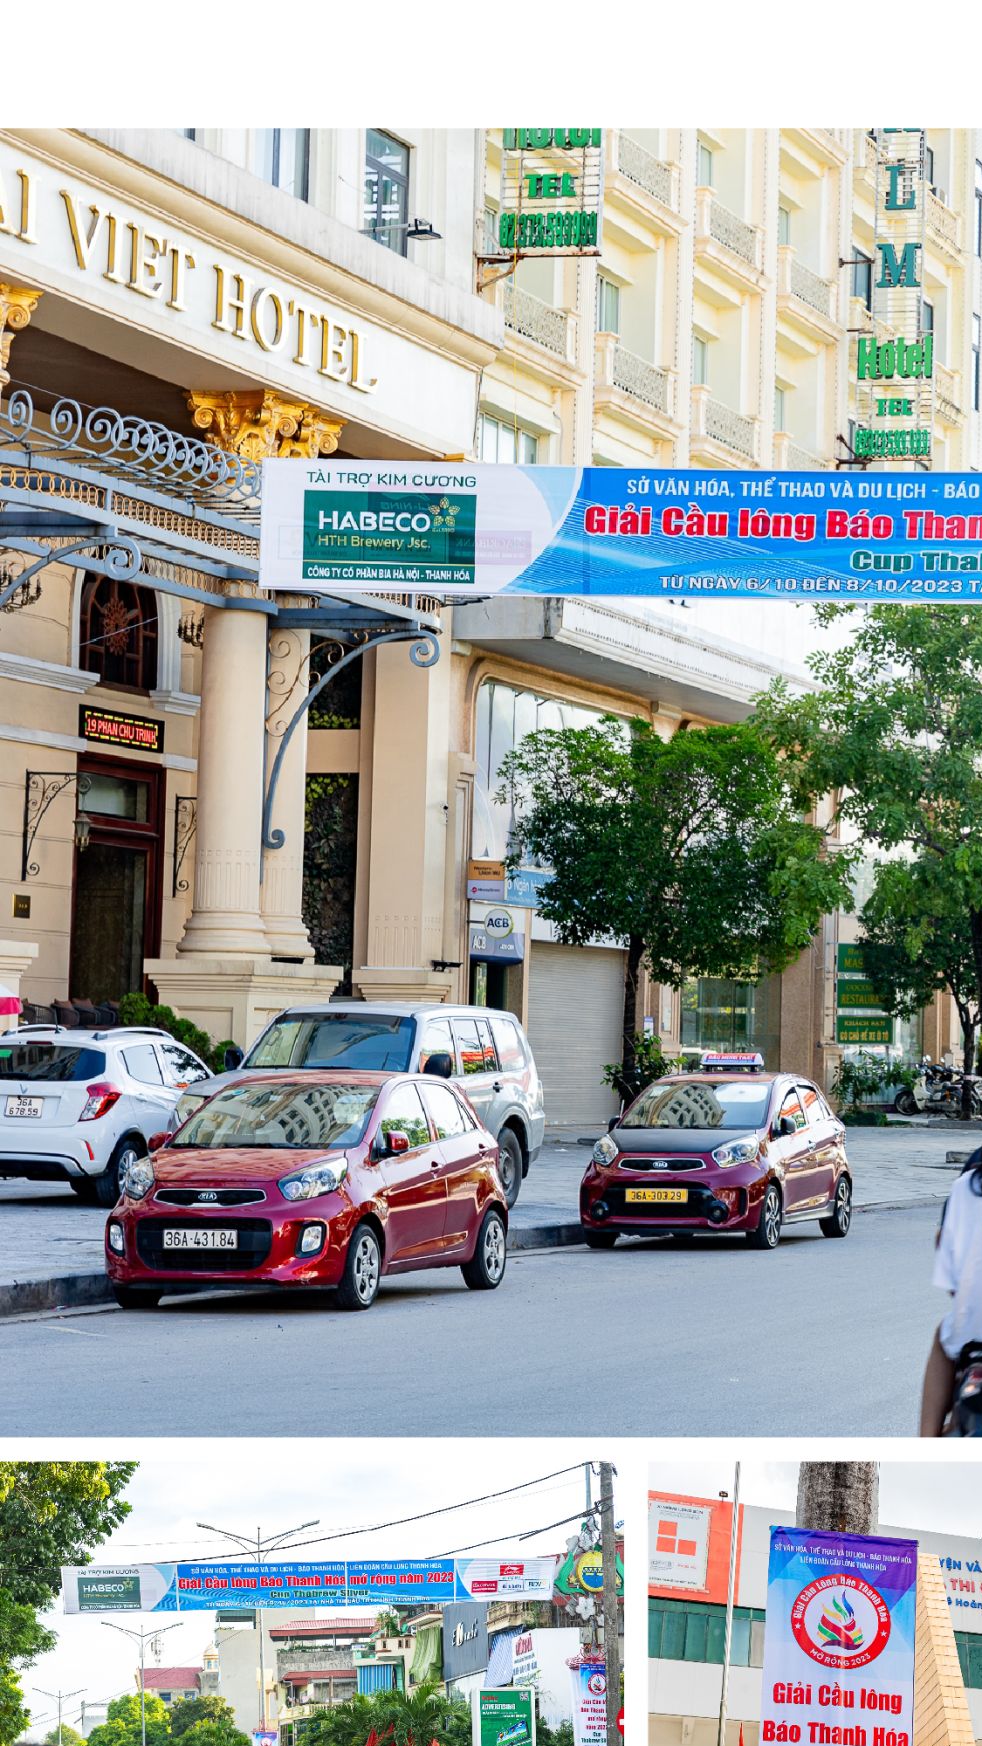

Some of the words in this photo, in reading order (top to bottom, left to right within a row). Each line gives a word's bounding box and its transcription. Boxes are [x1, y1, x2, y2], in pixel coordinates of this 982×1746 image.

[524, 172, 576, 199] TEL
[60, 188, 196, 312] VIET
[211, 262, 379, 394] HOTEL
[857, 336, 933, 380] Hotel
[627, 479, 650, 497] SỞ
[654, 479, 686, 497] VĂN
[694, 479, 735, 499] HÓA,
[740, 476, 775, 498] THỂ
[779, 482, 825, 499] THAO
[830, 479, 855, 499] VÀ
[858, 482, 884, 499] DU
[887, 482, 928, 502] LỊCH
[944, 480, 980, 500] BÁO
[318, 511, 431, 532] HABECO
[584, 502, 652, 537] Giải
[661, 502, 728, 539] Cầu
[738, 507, 816, 542] lông
[826, 509, 894, 541] Báo
[318, 535, 347, 547] HTH
[351, 536, 404, 550] Brewery
[407, 537, 431, 549] Jsc.
[850, 550, 912, 573] Cup
[660, 574, 687, 590] TỪ
[689, 575, 741, 591] NGÀY
[746, 576, 798, 593] 6/10
[802, 575, 843, 593] ĐẾN
[846, 576, 963, 594] 8/10/2023
[87, 718, 97, 732] 19
[135, 727, 156, 743] TRINH
[487, 918, 509, 928] ACB
[17, 1098, 33, 1107] 36A
[198, 1192, 217, 1200] KIA
[966, 1559, 982, 1574] VÀ
[83, 1584, 124, 1593] HABECO
[950, 1578, 976, 1593] THI
[773, 1681, 811, 1705] Giải
[818, 1681, 855, 1707] Cầu
[860, 1689, 903, 1714] lông
[763, 1720, 801, 1743] Báo
[807, 1722, 867, 1746] Thanh
